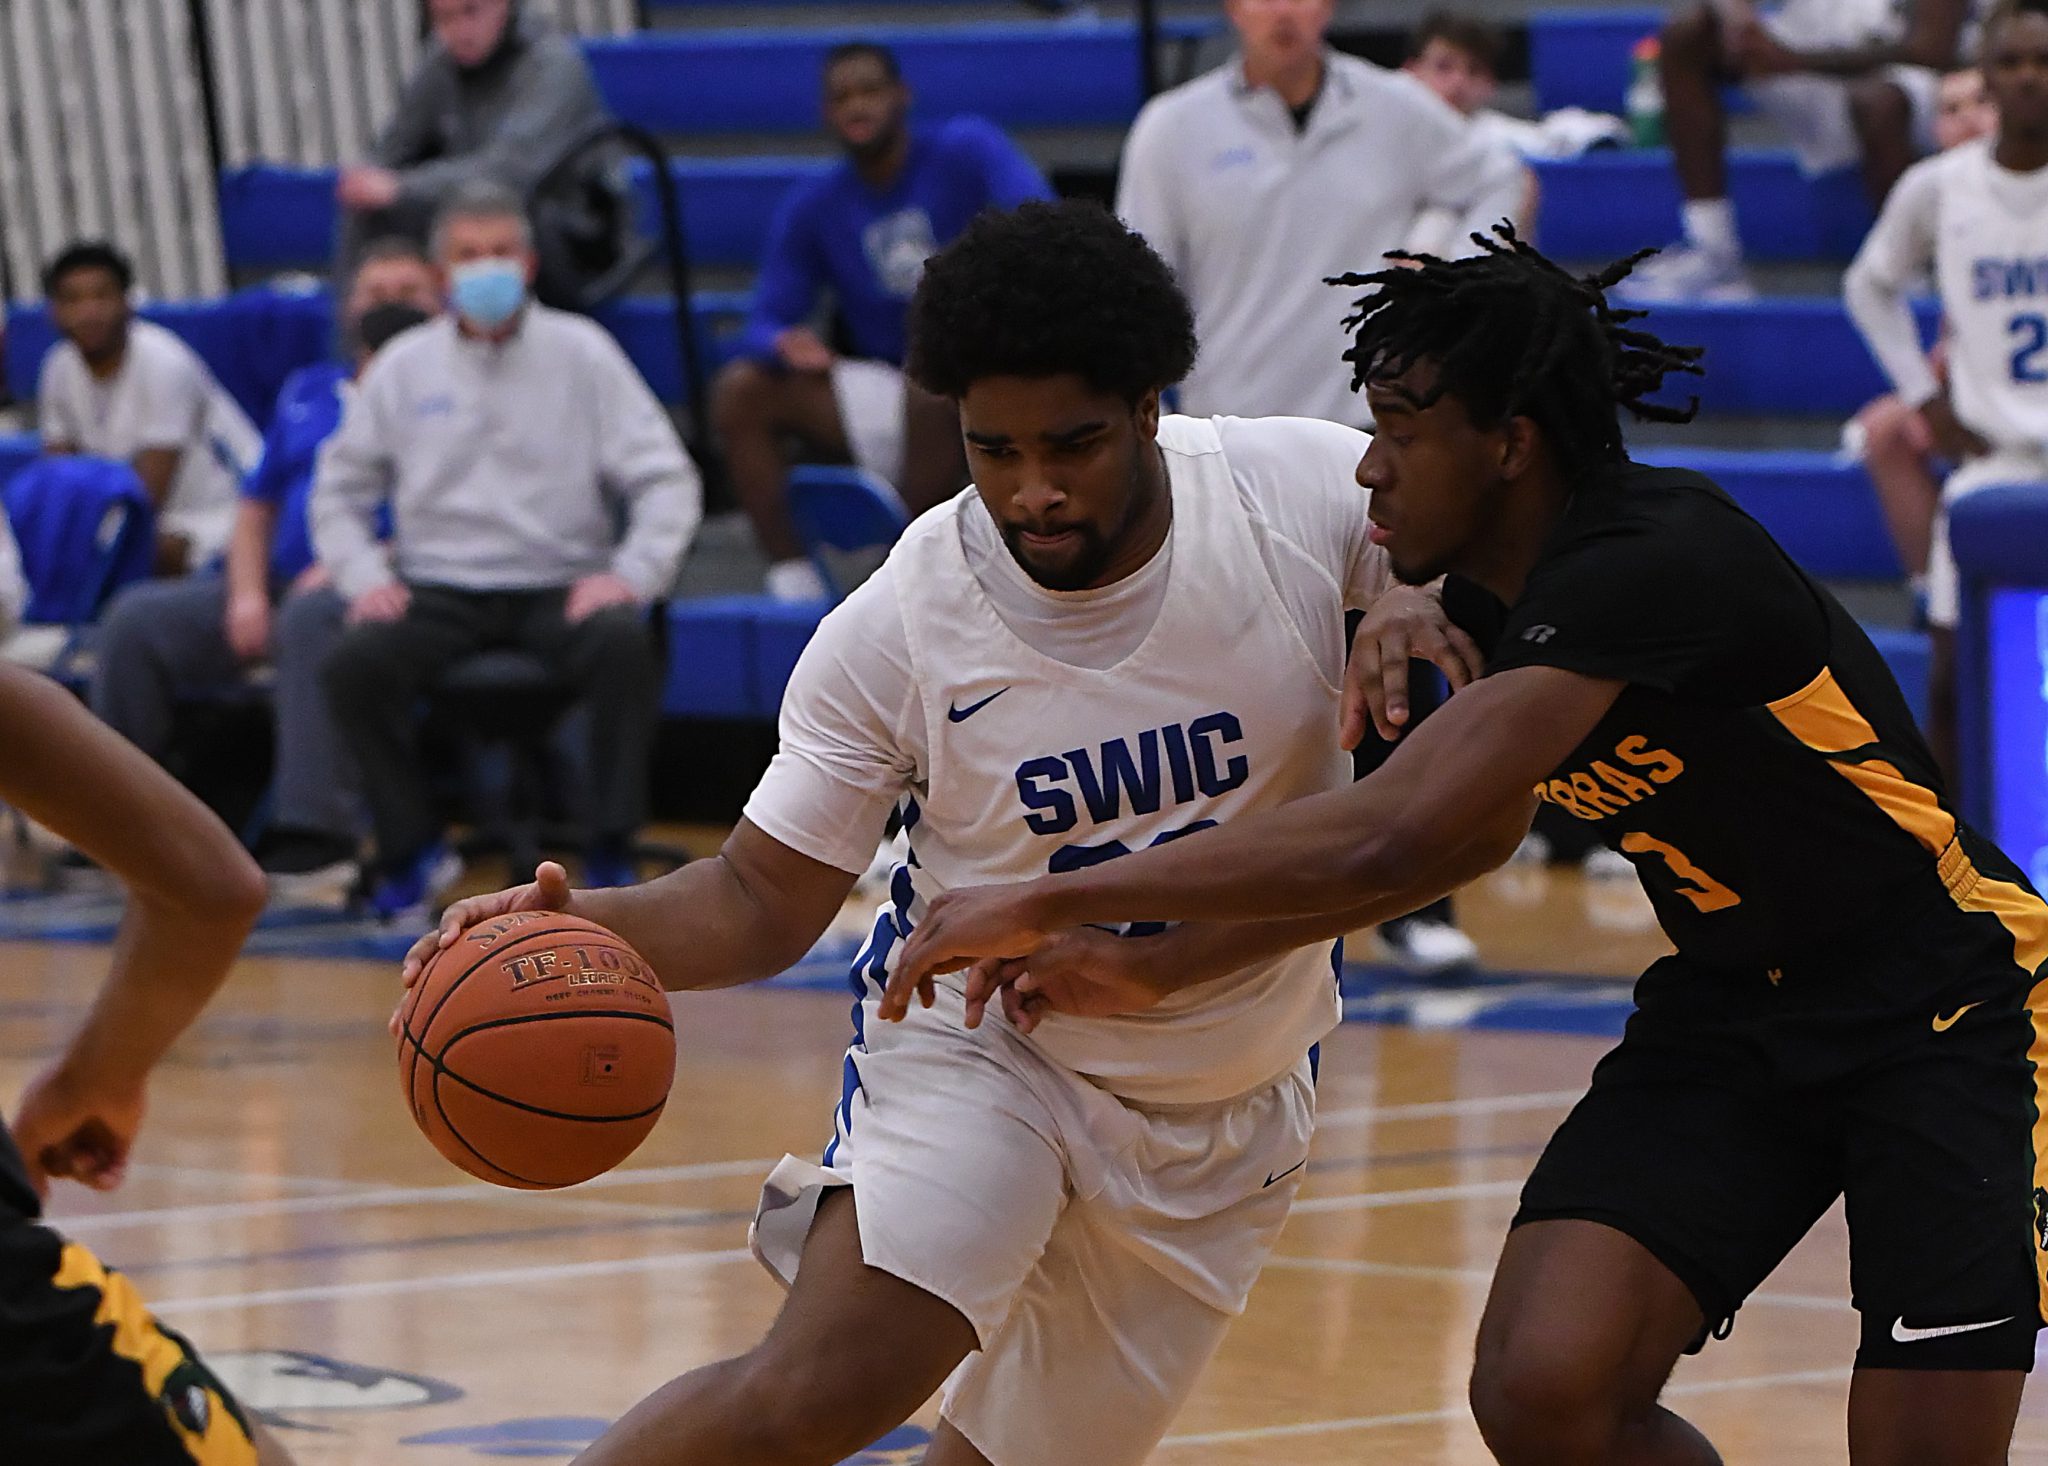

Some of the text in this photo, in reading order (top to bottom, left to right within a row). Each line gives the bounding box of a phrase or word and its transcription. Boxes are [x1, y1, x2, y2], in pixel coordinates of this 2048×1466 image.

[1015, 712, 1249, 835] SWIC
[1620, 831, 1741, 913] 3
[568, 972, 627, 987] LEGACY
